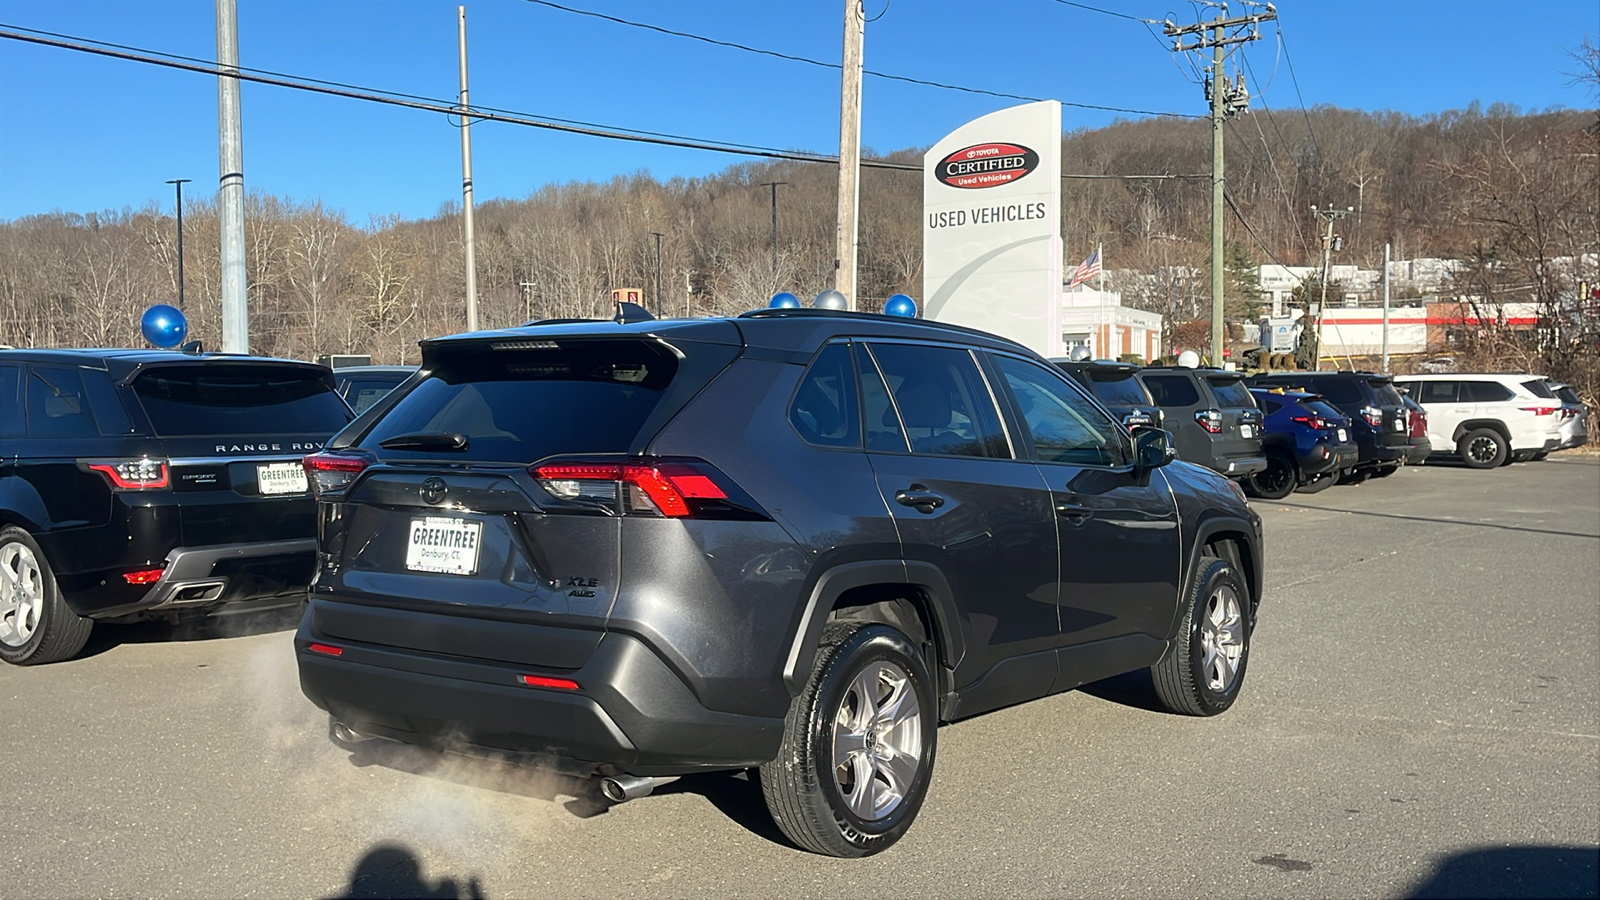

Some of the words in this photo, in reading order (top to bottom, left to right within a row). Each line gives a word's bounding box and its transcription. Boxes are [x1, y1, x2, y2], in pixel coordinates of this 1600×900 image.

[976, 148, 999, 156] TOYOTA
[946, 157, 1025, 176] CERTIFIED
[958, 177, 977, 185] Used
[978, 173, 1012, 183] Vehicles
[929, 210, 966, 229] USED
[971, 202, 1046, 224] VEHICLES
[215, 443, 281, 453] RANGE
[292, 442, 325, 450] ROV
[261, 468, 304, 481] GREENTREE
[413, 527, 476, 549] GREENTREE
[567, 576, 600, 588] XLE
